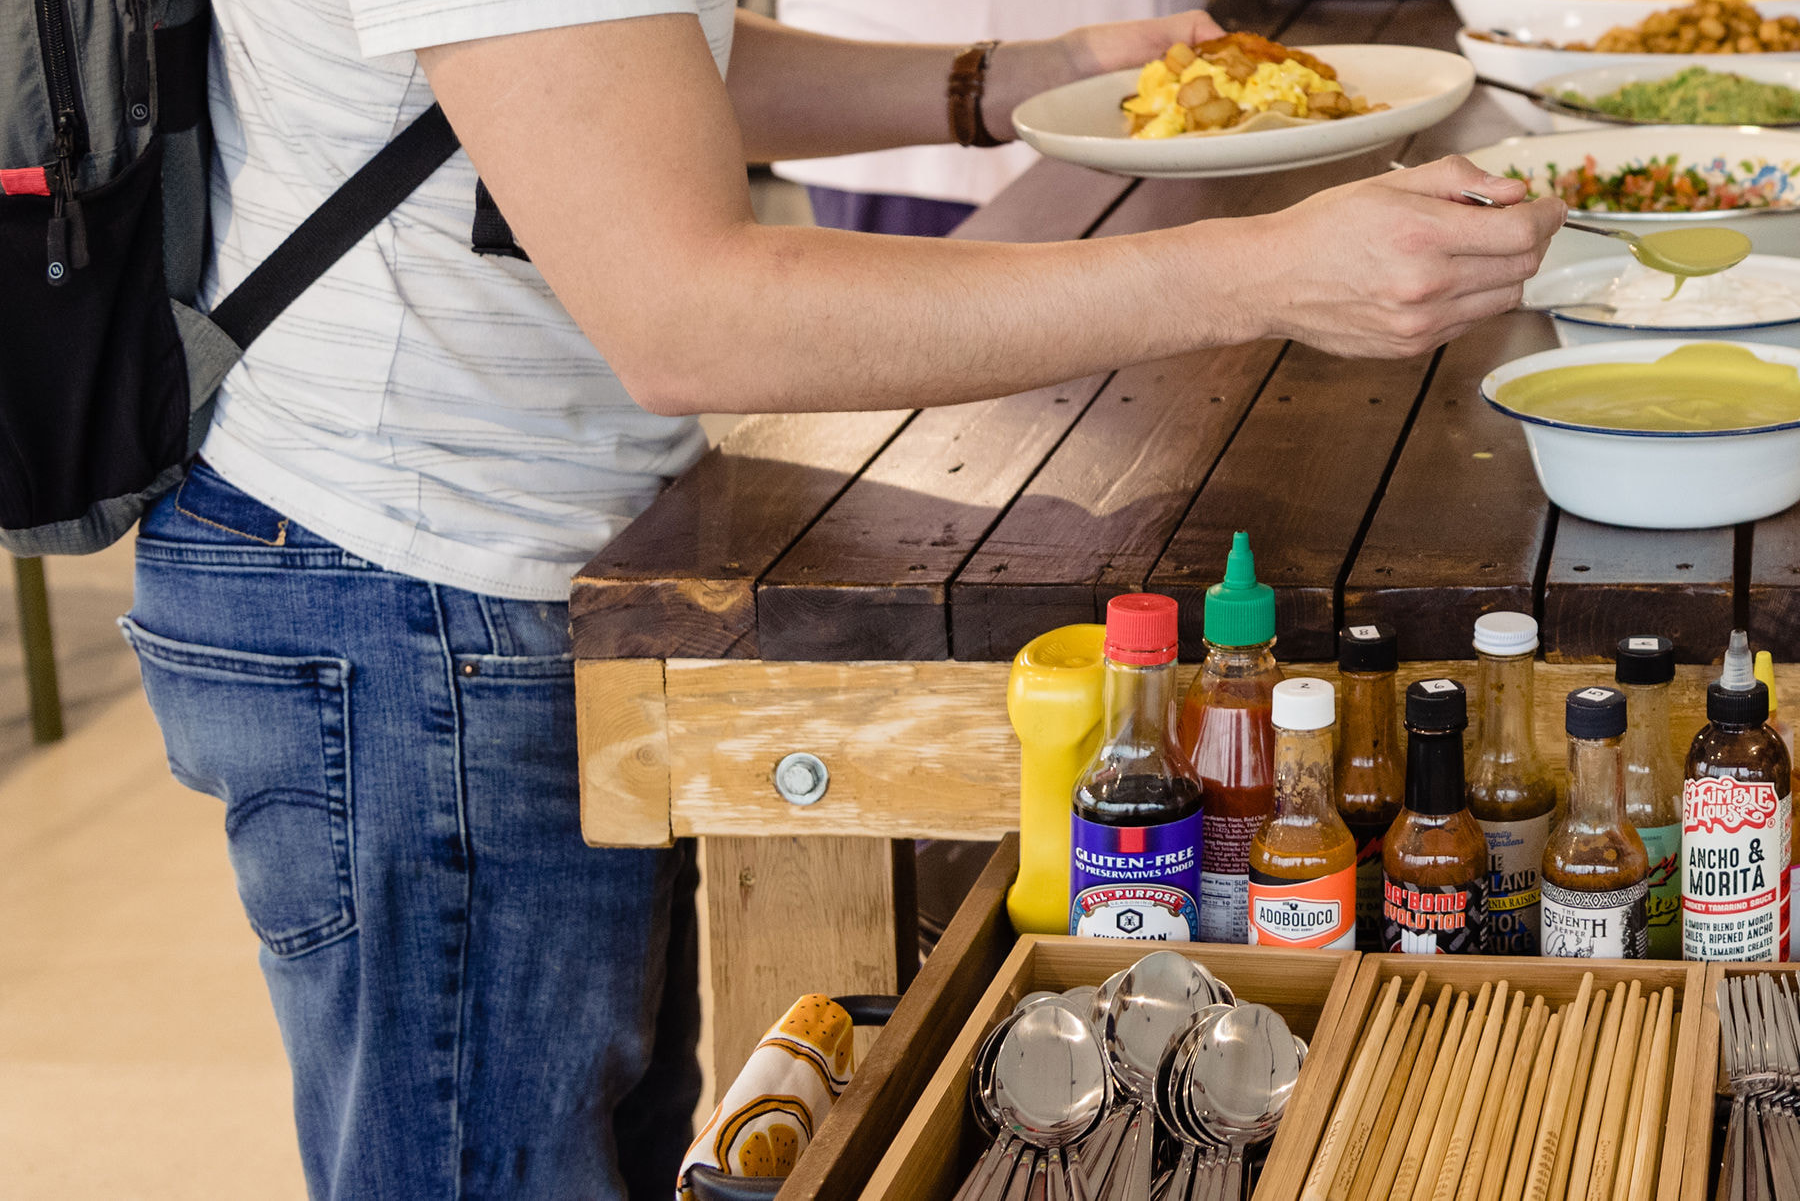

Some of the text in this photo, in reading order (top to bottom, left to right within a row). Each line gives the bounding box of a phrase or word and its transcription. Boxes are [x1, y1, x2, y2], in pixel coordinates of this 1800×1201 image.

[1075, 846, 1194, 868] GLUTEN-FREE
[1689, 838, 1765, 869] ANCHO &
[1086, 866, 1161, 879] PRESERVATIVES
[1164, 859, 1194, 875] ADDED
[1490, 868, 1539, 893] LAND
[1689, 864, 1765, 896] MORITA
[1384, 879, 1468, 912] DA'BOMB
[1509, 893, 1538, 907] RAISIN
[1708, 902, 1748, 912] TAMARIND
[1750, 894, 1774, 907] SAUCE
[1260, 907, 1333, 927] ADOBOLOCO
[1544, 906, 1608, 938] SEVENTH
[1562, 908, 1576, 917] THE
[1689, 919, 1711, 931] SMOOTH
[1713, 922, 1735, 931] BLEND
[1737, 920, 1745, 930] OF
[1748, 911, 1773, 927] MORITA
[1554, 924, 1586, 938] REAPER
[1709, 932, 1744, 944] RIPENED
[1747, 922, 1774, 940] ANCHO
[1487, 932, 1532, 955] AUCE
[1710, 946, 1745, 956] TAMARIND
[1747, 936, 1773, 952] CREATES
